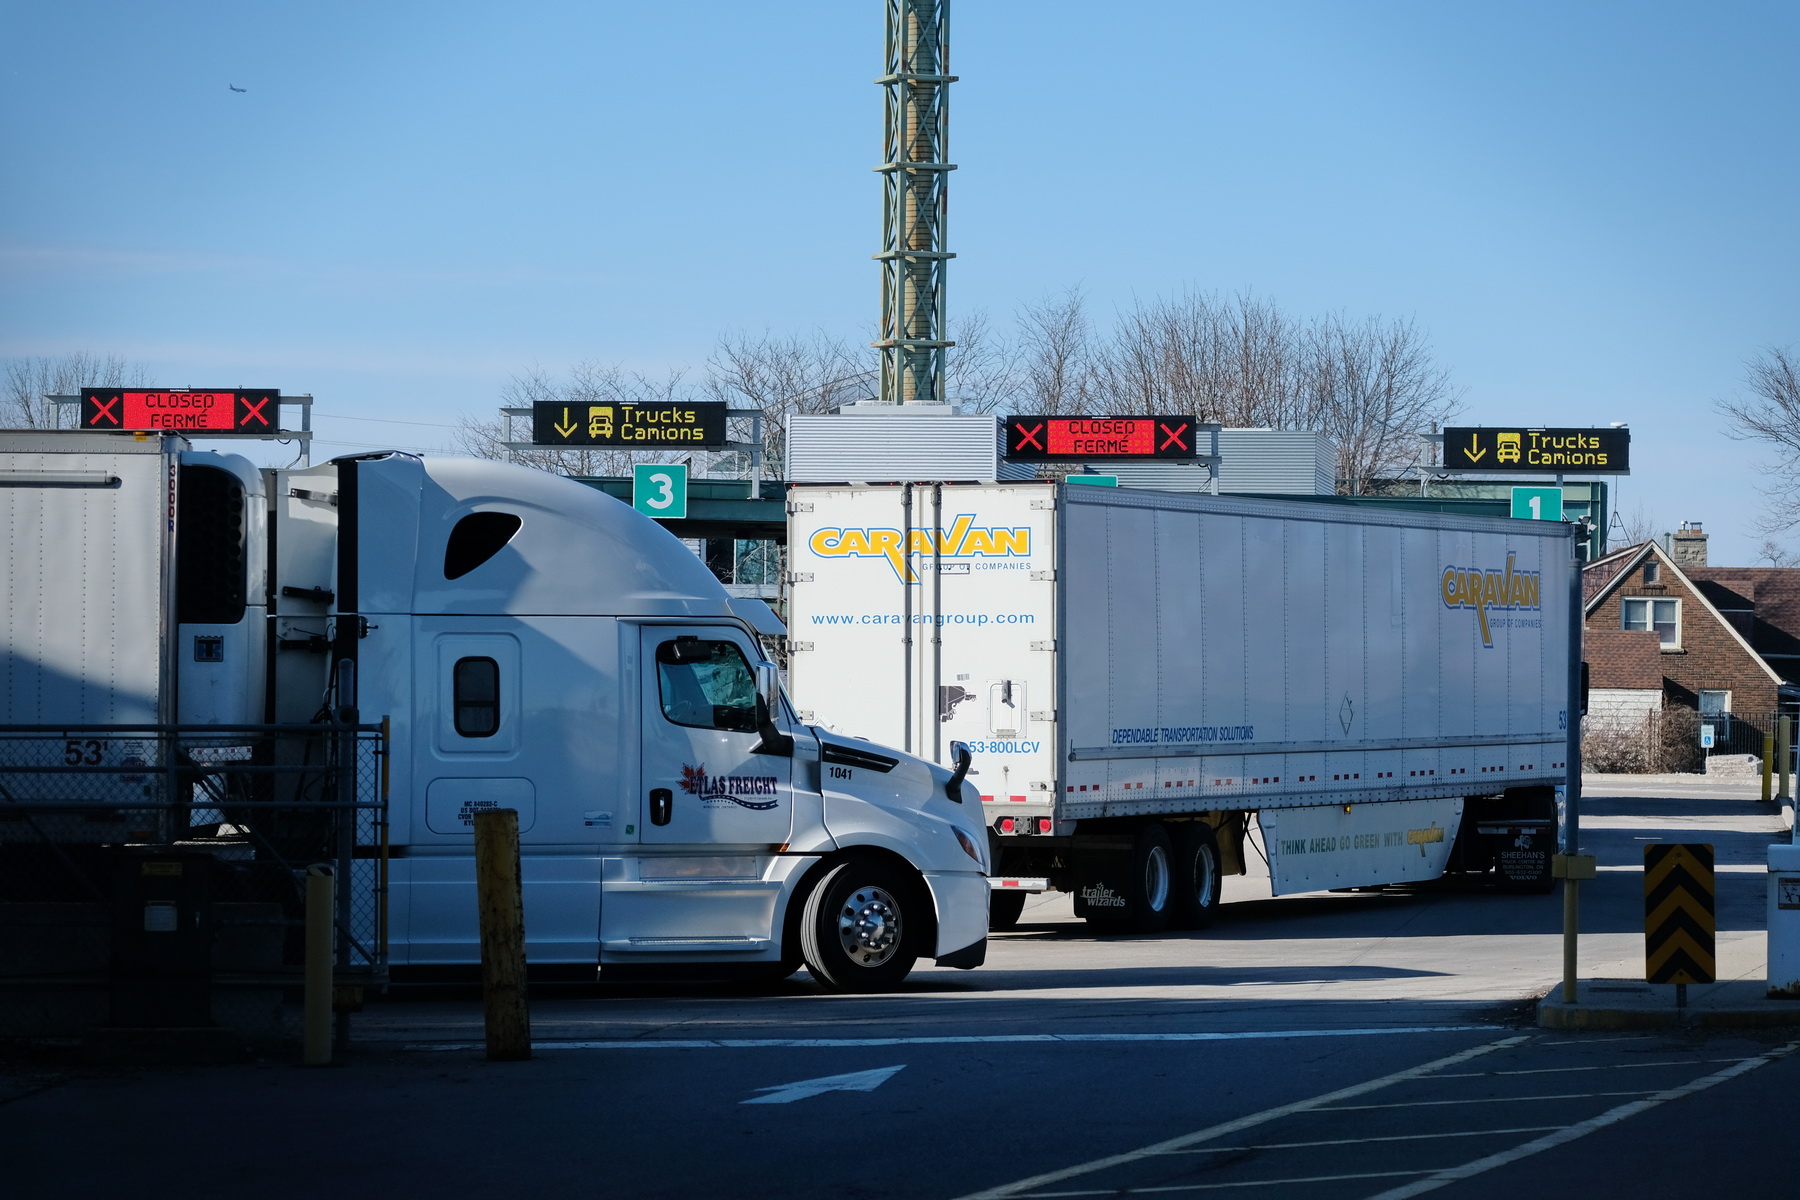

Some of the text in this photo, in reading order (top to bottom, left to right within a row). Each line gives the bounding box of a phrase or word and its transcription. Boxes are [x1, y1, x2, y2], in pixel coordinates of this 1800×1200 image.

[145, 394, 215, 408] CLOSED
[150, 409, 208, 428] FERMÉ
[621, 406, 696, 423] Trucks
[621, 424, 704, 440] Camions
[1068, 421, 1135, 434] CLOSED
[1073, 435, 1129, 453] FERMÉ
[1528, 432, 1600, 449] Trucks
[1528, 449, 1608, 465] Camions
[167, 464, 176, 532] 3000R
[646, 473, 674, 509] 3
[1528, 496, 1541, 520] 1
[808, 513, 1031, 585] CARAVAN
[975, 562, 1032, 570] COMPANIES
[1441, 551, 1541, 648] CARAVAN
[811, 613, 1035, 627] www.caravangroup.com
[1490, 618, 1542, 629] GROUP OF COMPANIES
[1558, 710, 1567, 730] 53
[1112, 725, 1254, 744] DEPENDABLE TRANSPORTATION SOLUTIONS
[829, 766, 852, 780] 1041
[689, 776, 778, 795] ETLAS FREIGHT
[1281, 839, 1306, 855] THINK
[1309, 837, 1336, 853] AHEAD
[1339, 835, 1351, 851] GO
[1354, 834, 1380, 850] GREEN
[1384, 832, 1403, 848] WITH
[1501, 851, 1545, 859] SHEEHAN'S
[1081, 882, 1115, 898] trailer
[1087, 895, 1126, 907] wizards
